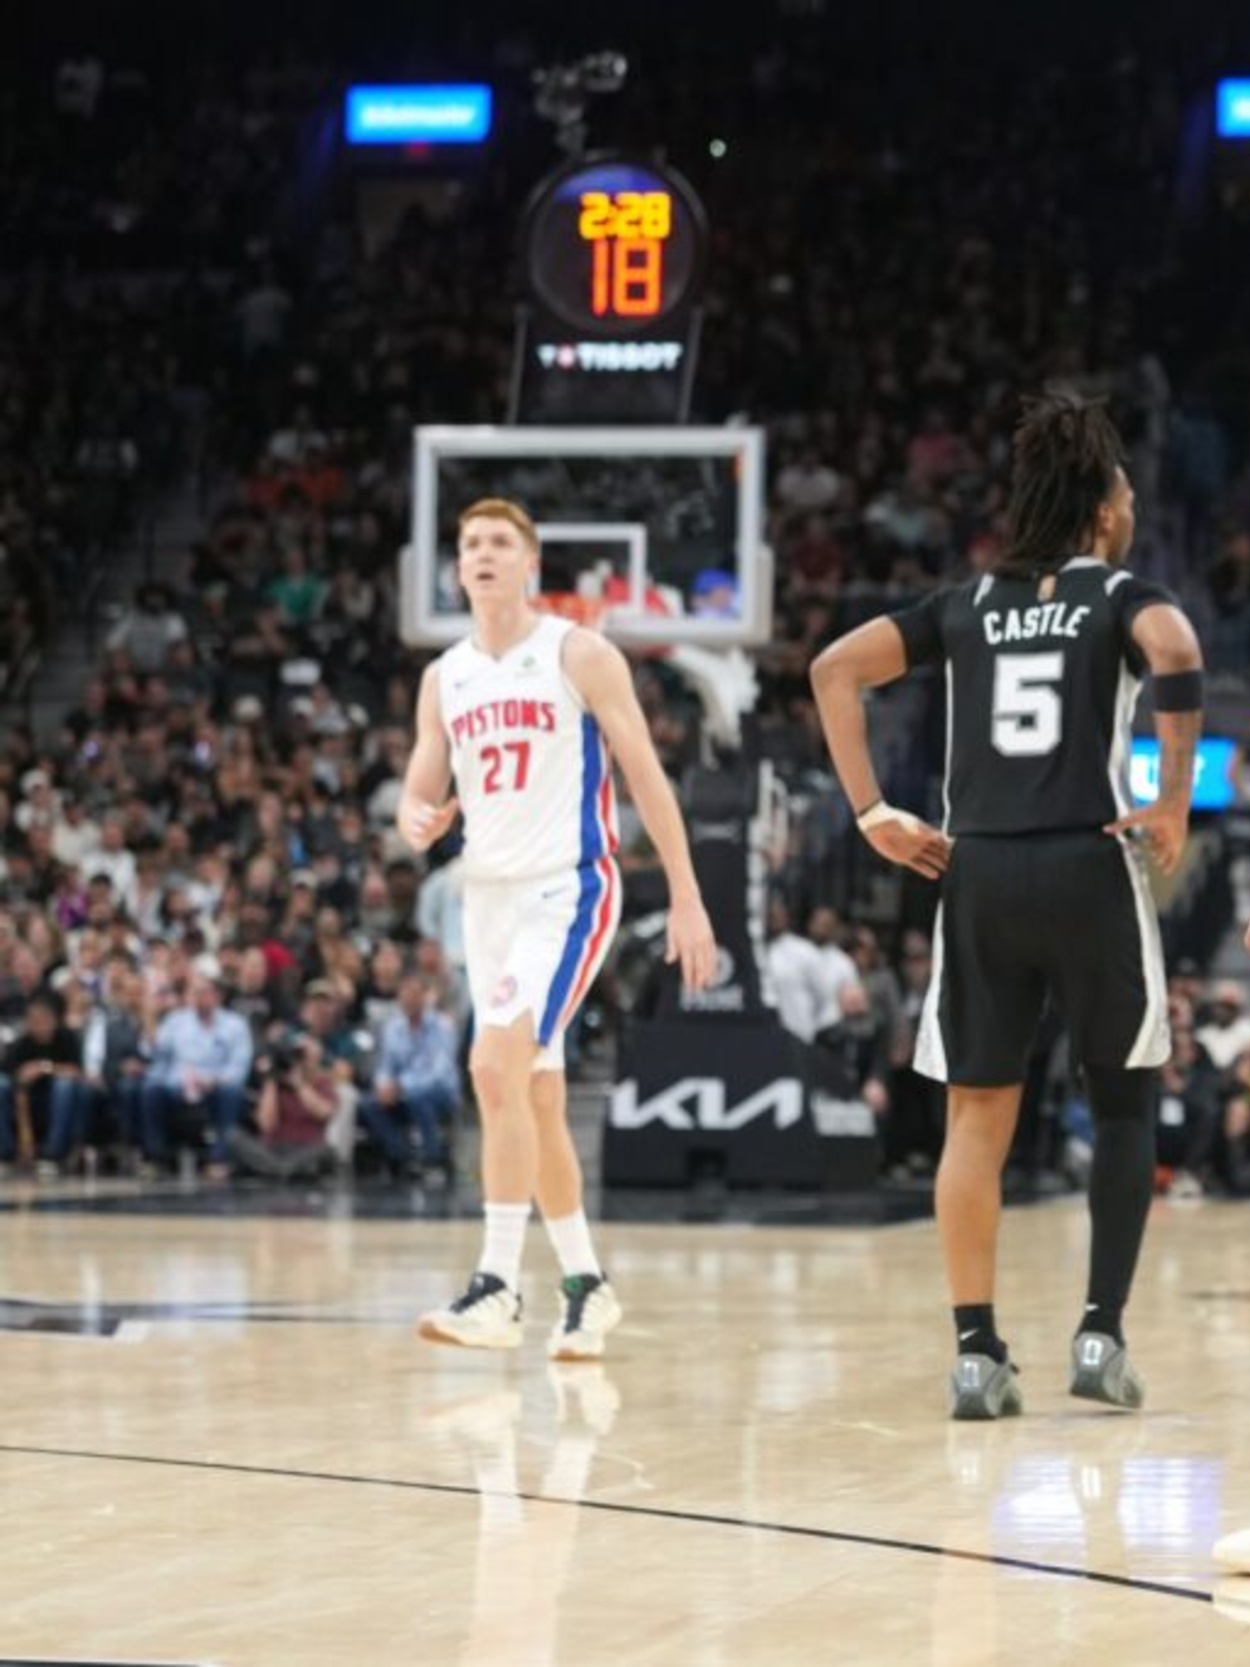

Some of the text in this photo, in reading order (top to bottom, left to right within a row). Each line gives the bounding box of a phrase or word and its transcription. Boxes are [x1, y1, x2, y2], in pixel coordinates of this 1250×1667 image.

[579, 191, 671, 240] 2:28
[592, 236, 662, 317] 18
[982, 601, 1091, 645] CASTLE
[451, 699, 556, 748] PISTONS
[991, 651, 1064, 757] 5
[480, 741, 530, 794] 27
